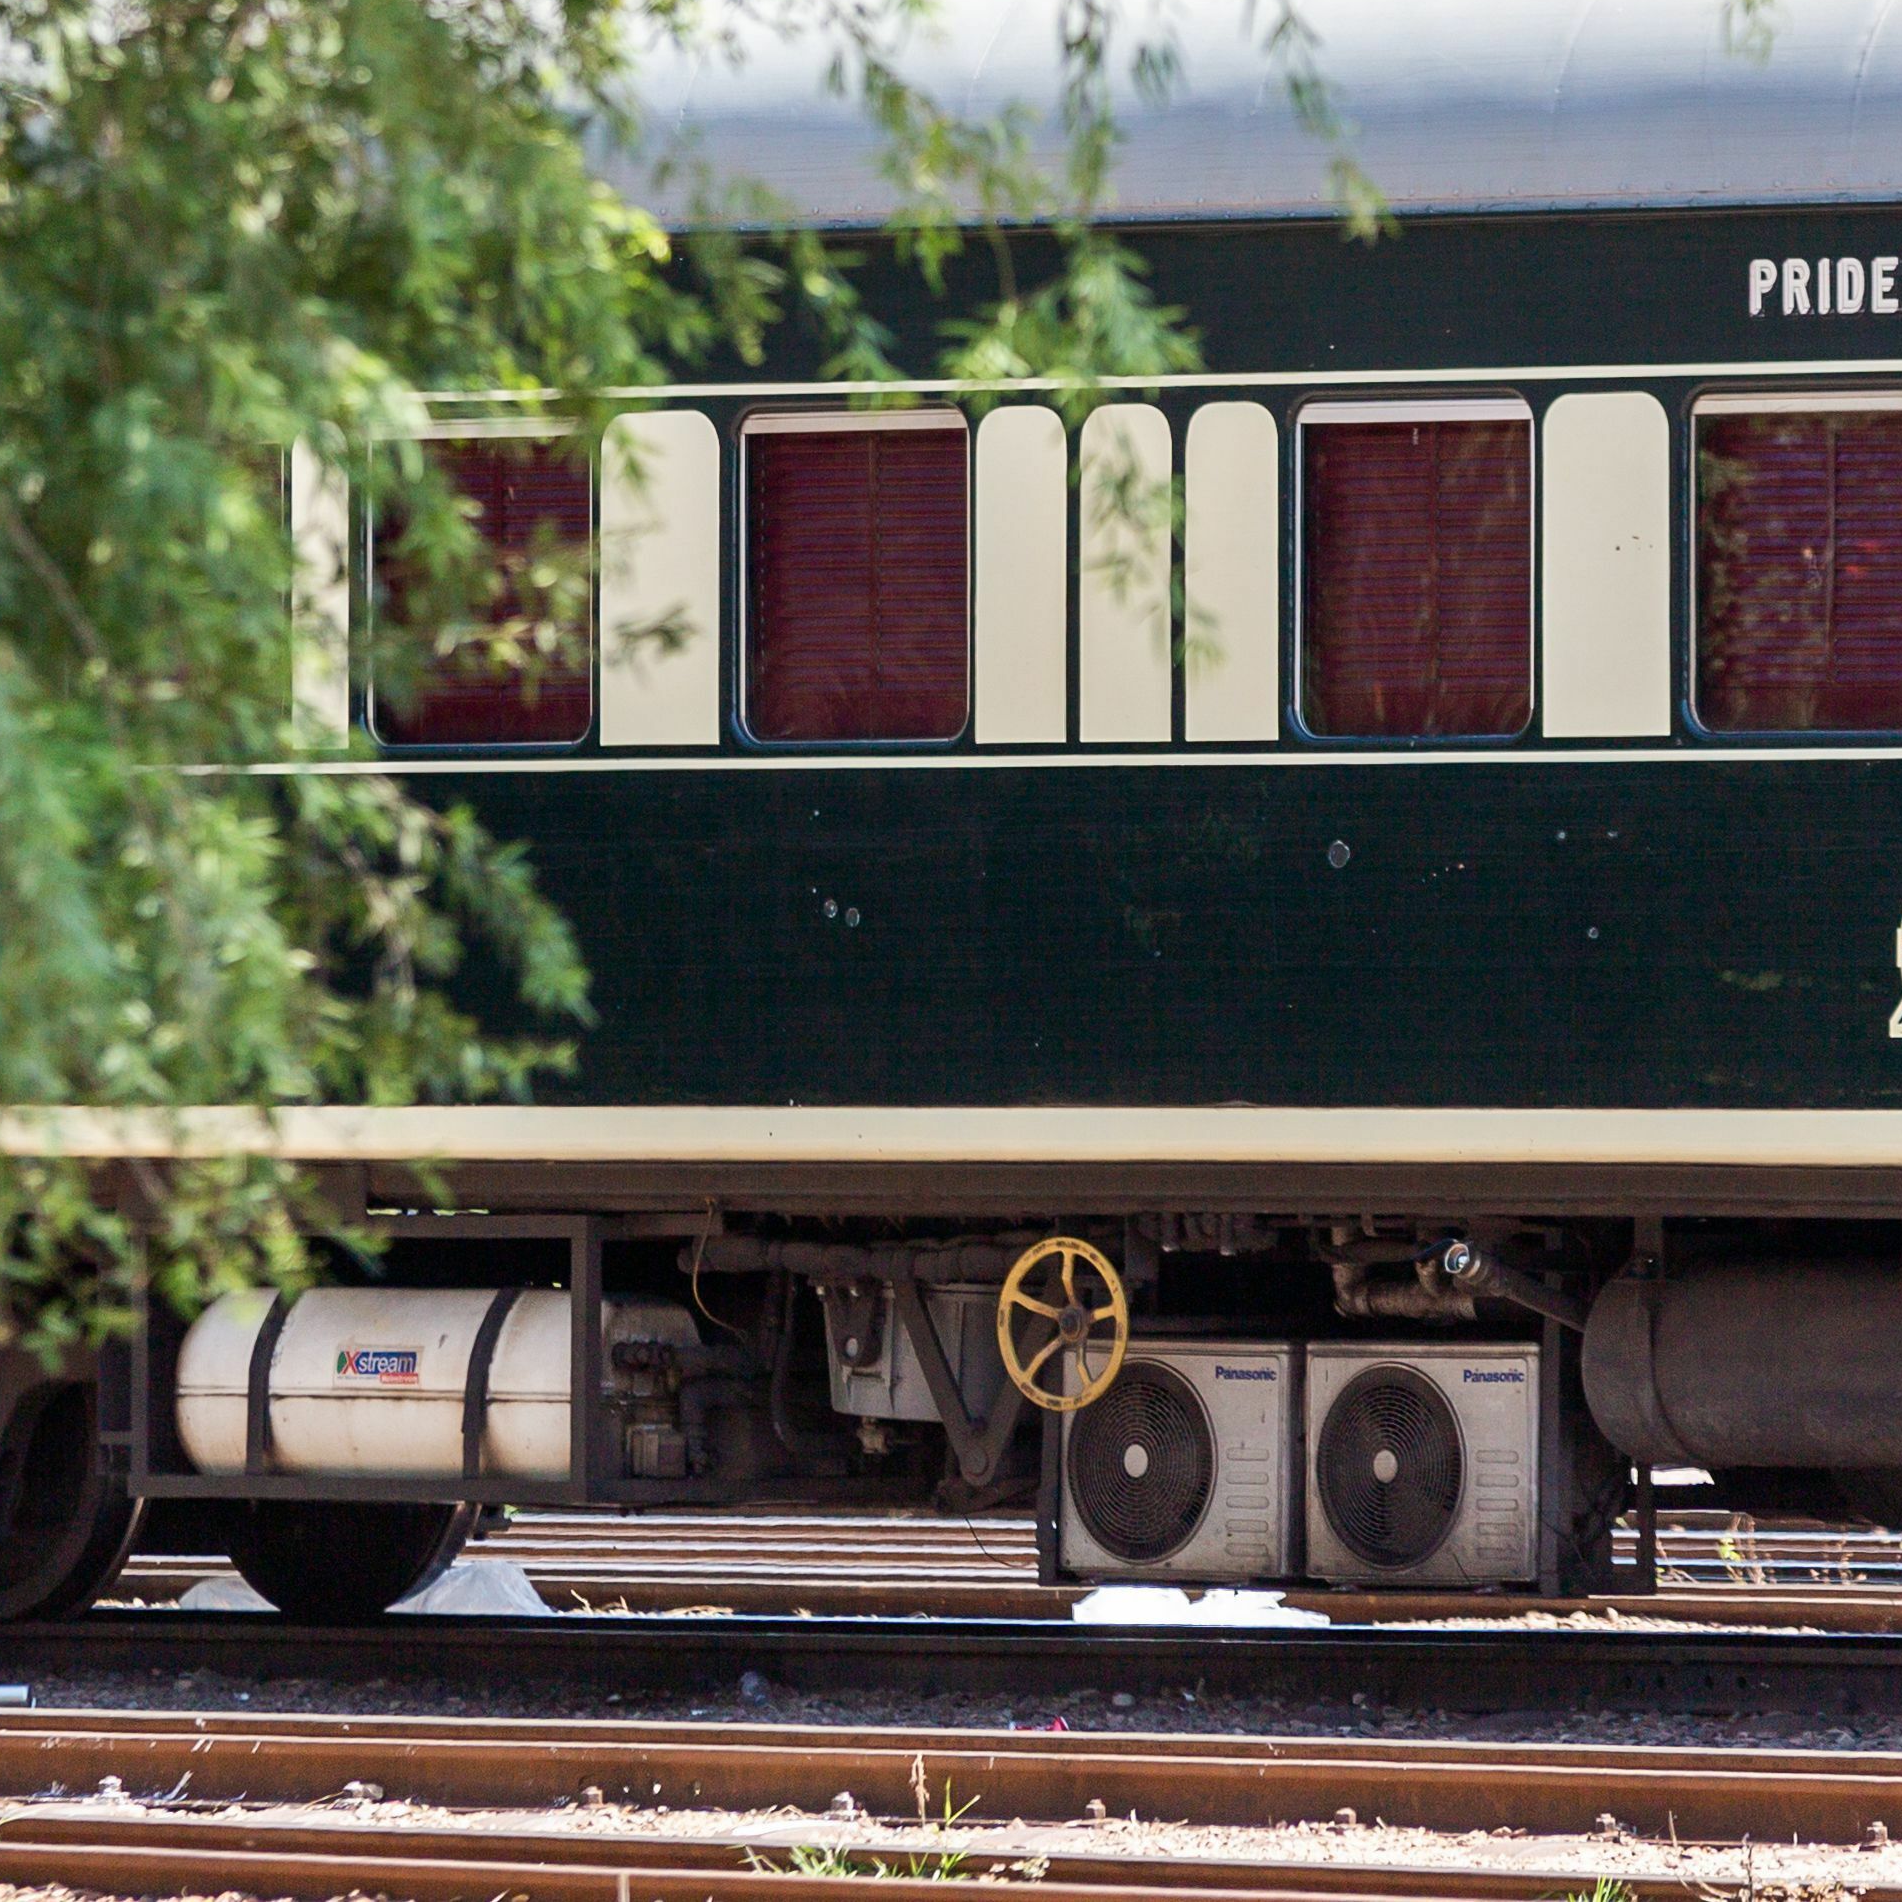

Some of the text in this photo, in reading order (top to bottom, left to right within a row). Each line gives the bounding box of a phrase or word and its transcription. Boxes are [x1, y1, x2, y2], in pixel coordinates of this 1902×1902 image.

[1748, 256, 1900, 316] PRIDE
[341, 1350, 414, 1375] Xstream
[1215, 1365, 1277, 1382] Panasonic
[1463, 1367, 1525, 1384] Panasonic
